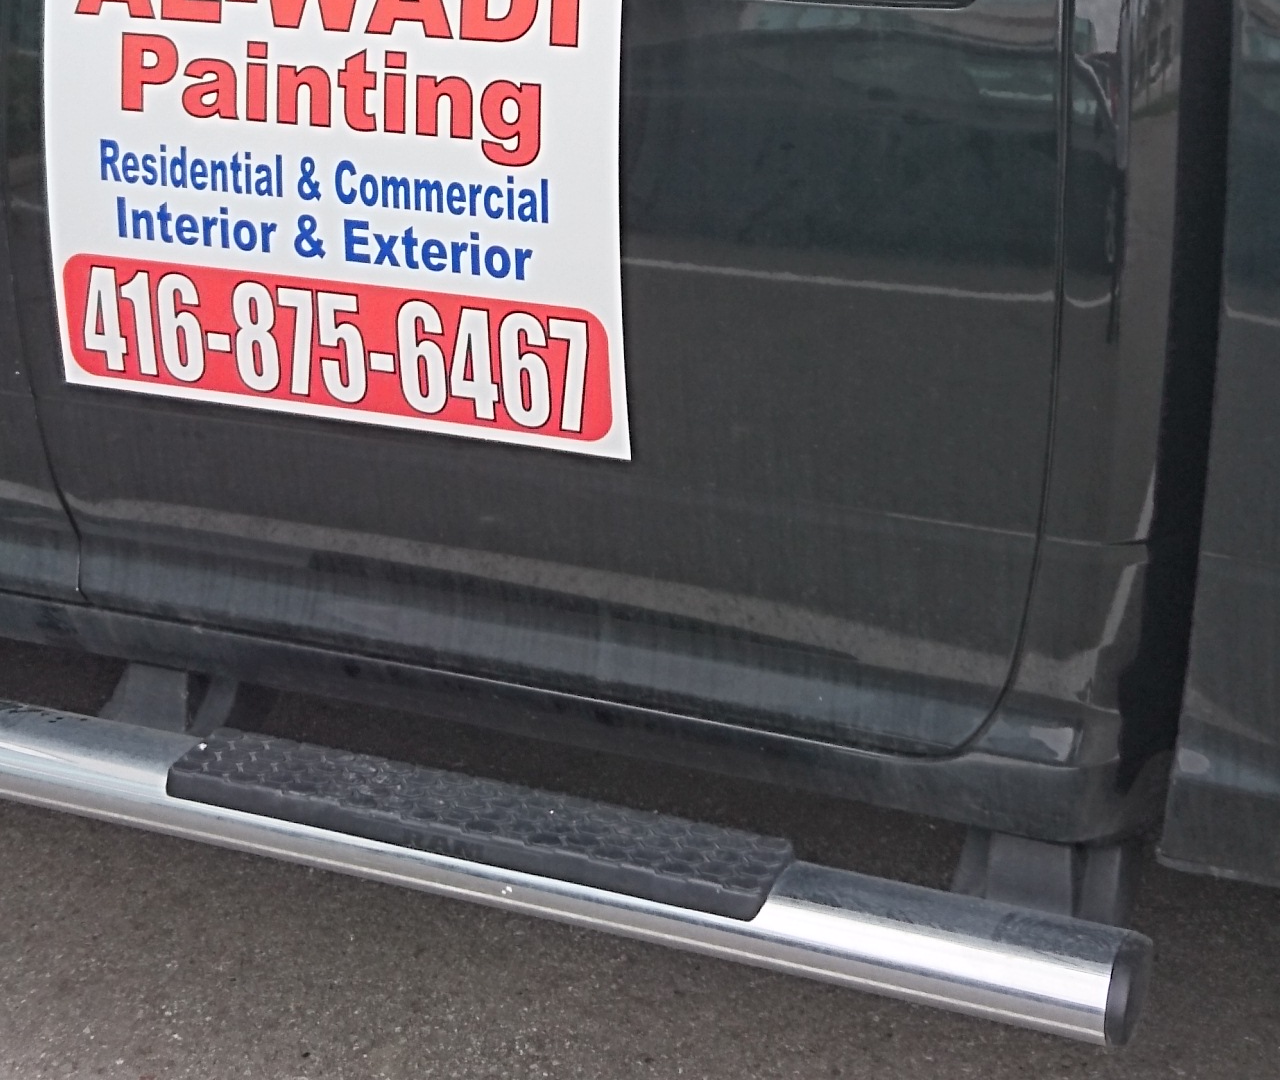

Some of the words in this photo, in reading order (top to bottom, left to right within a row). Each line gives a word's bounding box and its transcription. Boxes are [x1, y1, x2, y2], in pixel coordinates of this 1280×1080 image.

[120, 31, 542, 167] Painting
[99, 138, 284, 198] Residential
[297, 156, 322, 202] &
[334, 159, 549, 224] Commercial
[116, 196, 277, 253] Interior
[293, 214, 326, 259] &
[344, 219, 533, 281] Exterior
[83, 265, 589, 434] 416-875-6467
